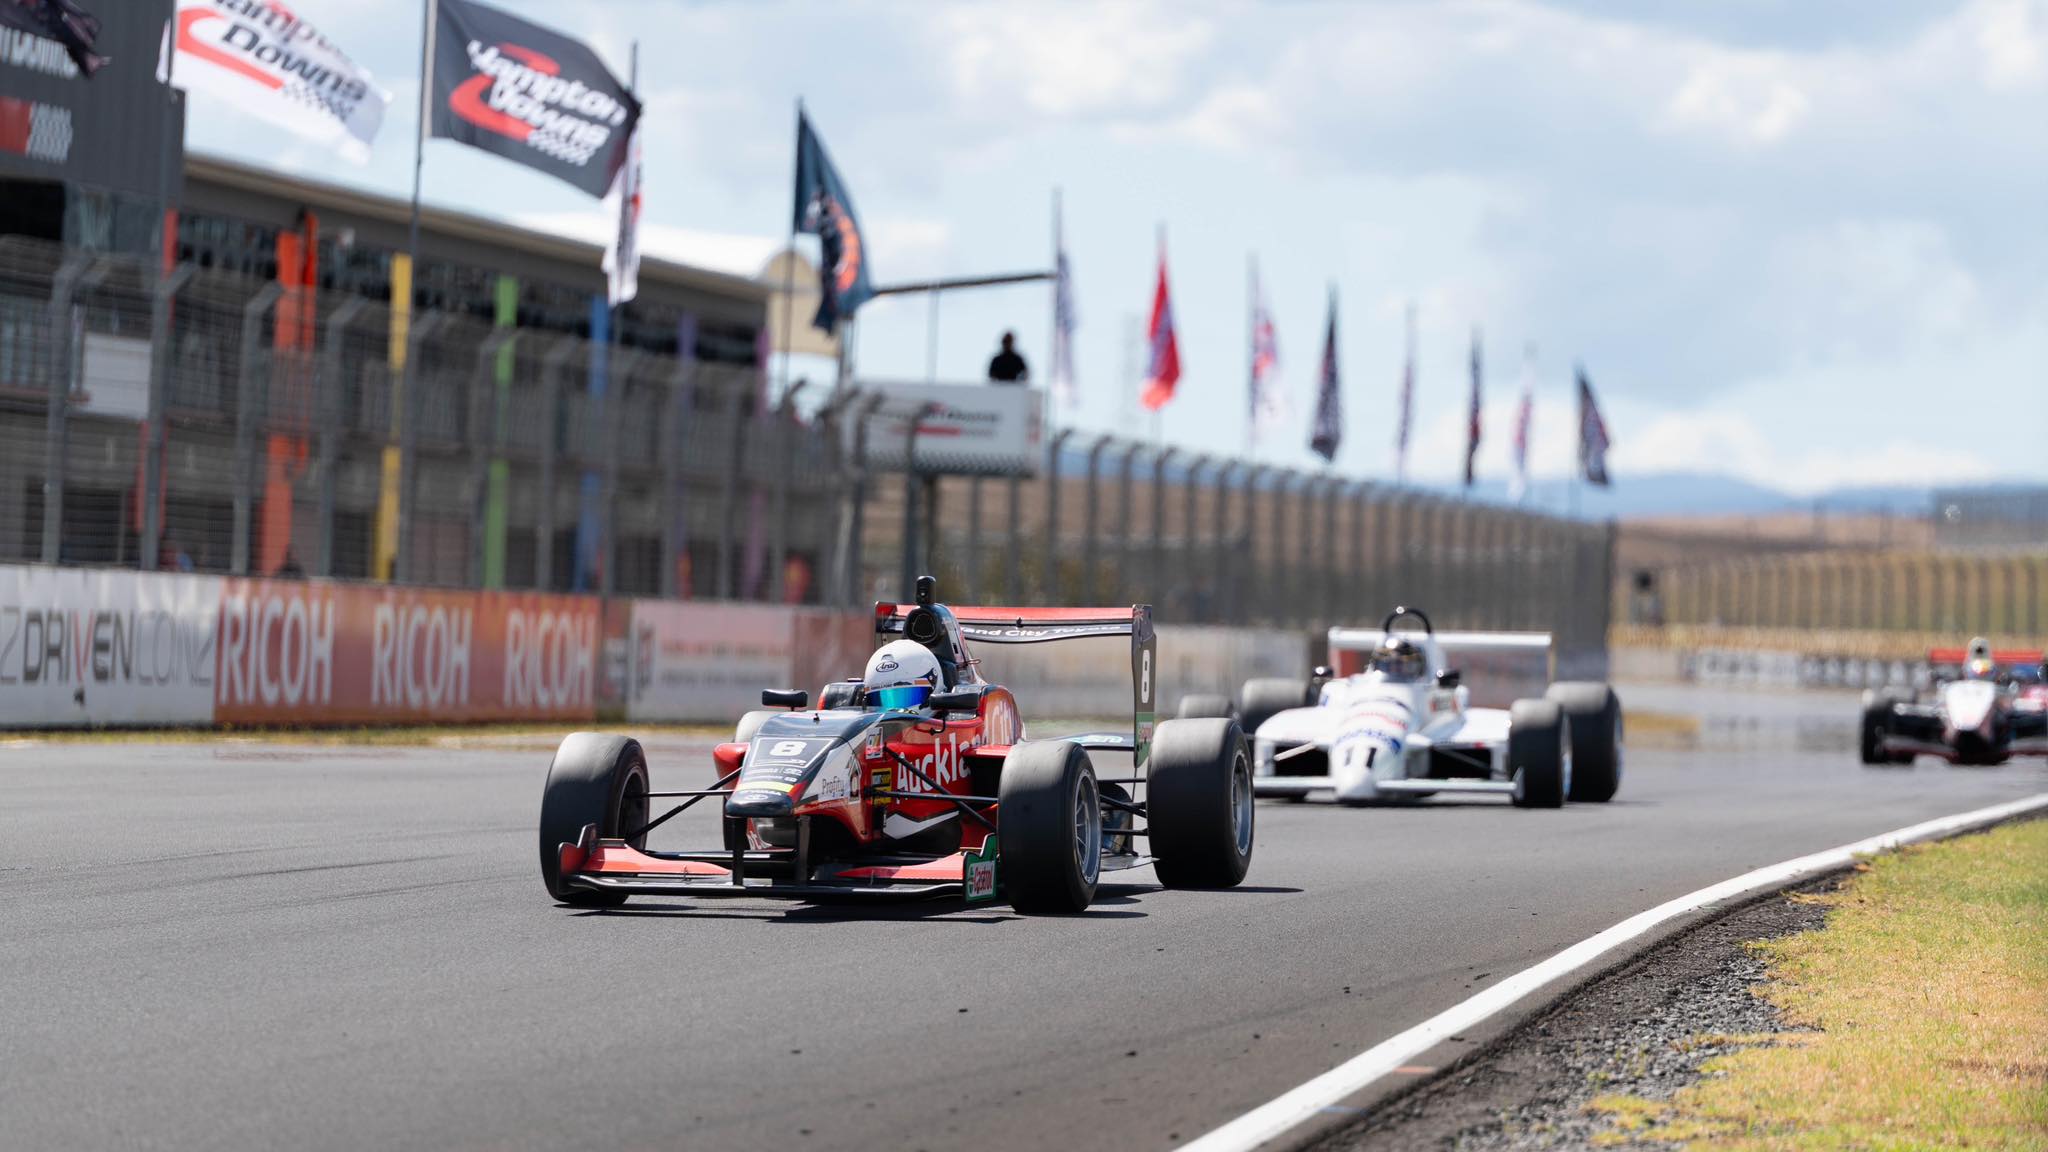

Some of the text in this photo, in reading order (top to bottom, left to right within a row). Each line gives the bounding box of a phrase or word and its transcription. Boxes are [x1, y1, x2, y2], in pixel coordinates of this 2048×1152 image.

[466, 39, 627, 126] Hampton
[489, 83, 610, 152] Downs
[219, 597, 335, 706] RICOH
[372, 602, 473, 706] RICOH
[504, 607, 596, 706] RICOH
[1005, 626, 1048, 638] City
[1141, 649, 1151, 704] 8
[769, 740, 808, 757] 8
[1344, 746, 1378, 770] 11
